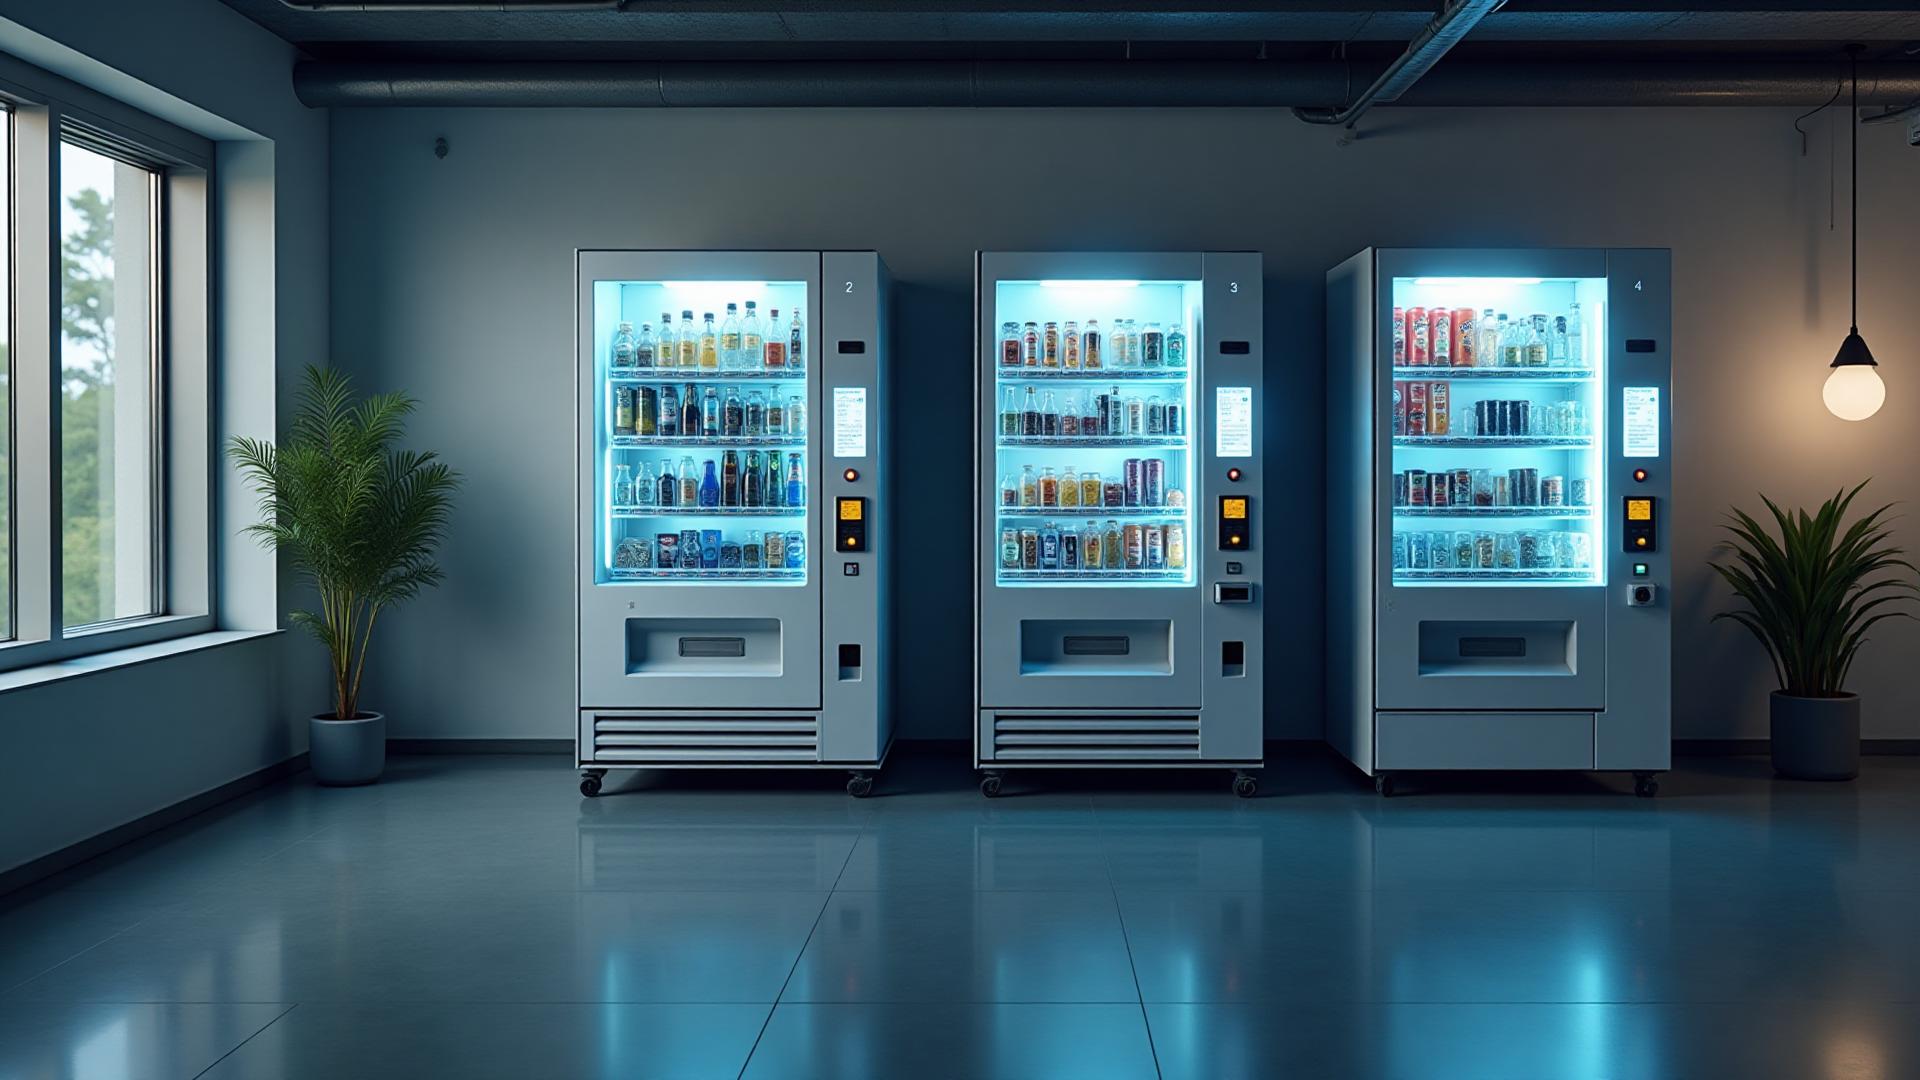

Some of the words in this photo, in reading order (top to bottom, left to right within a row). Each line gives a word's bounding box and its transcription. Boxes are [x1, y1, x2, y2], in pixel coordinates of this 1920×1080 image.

[845, 281, 853, 293] 2
[1230, 281, 1238, 293] 3
[1634, 280, 1642, 291] 4
